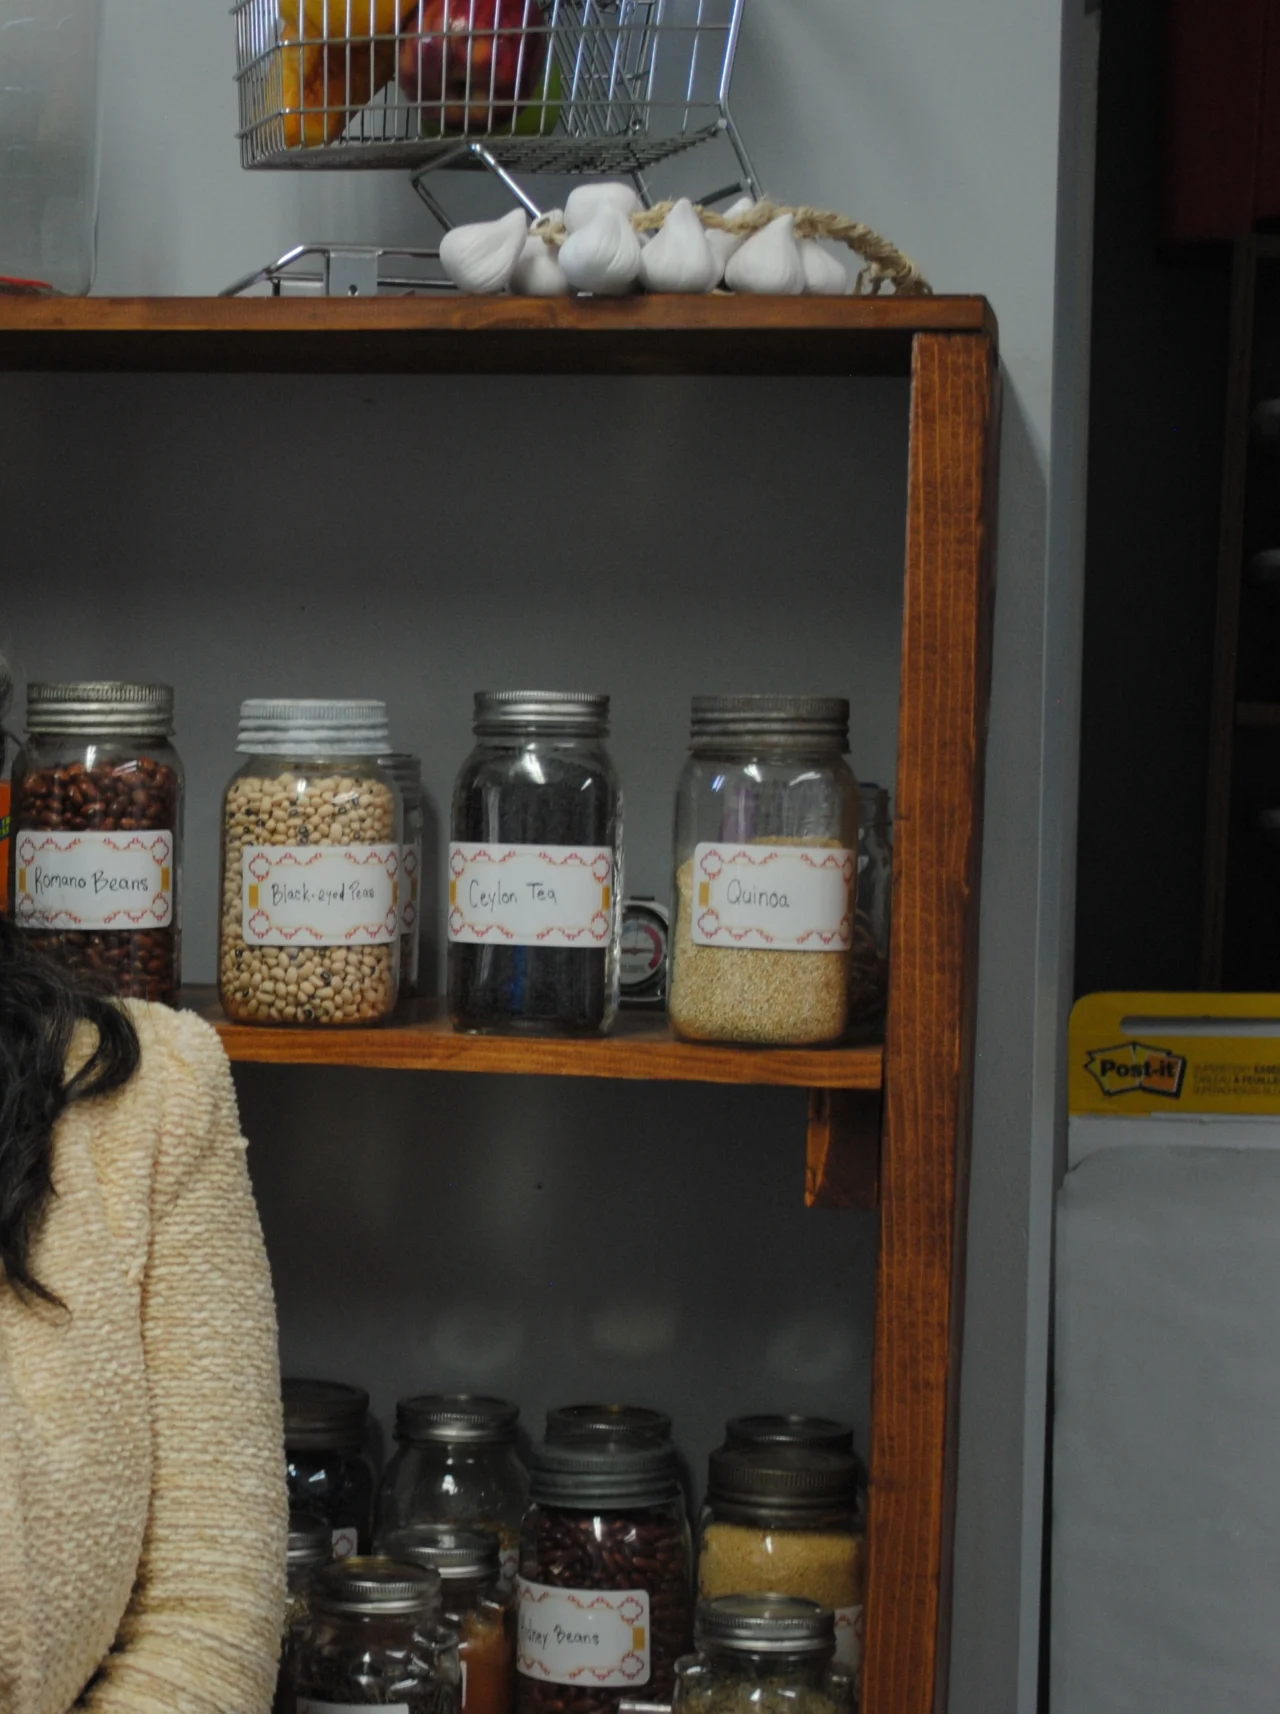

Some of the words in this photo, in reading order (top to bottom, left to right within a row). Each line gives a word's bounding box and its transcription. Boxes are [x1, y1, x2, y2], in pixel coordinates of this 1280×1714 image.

[33, 866, 87, 895] Romano
[92, 870, 149, 894] Beans
[726, 878, 791, 910] Quinoa
[468, 878, 518, 914] Ceylon
[526, 881, 557, 903] Tea
[1100, 1059, 1176, 1079] Post-it
[553, 1624, 600, 1646] Beans
